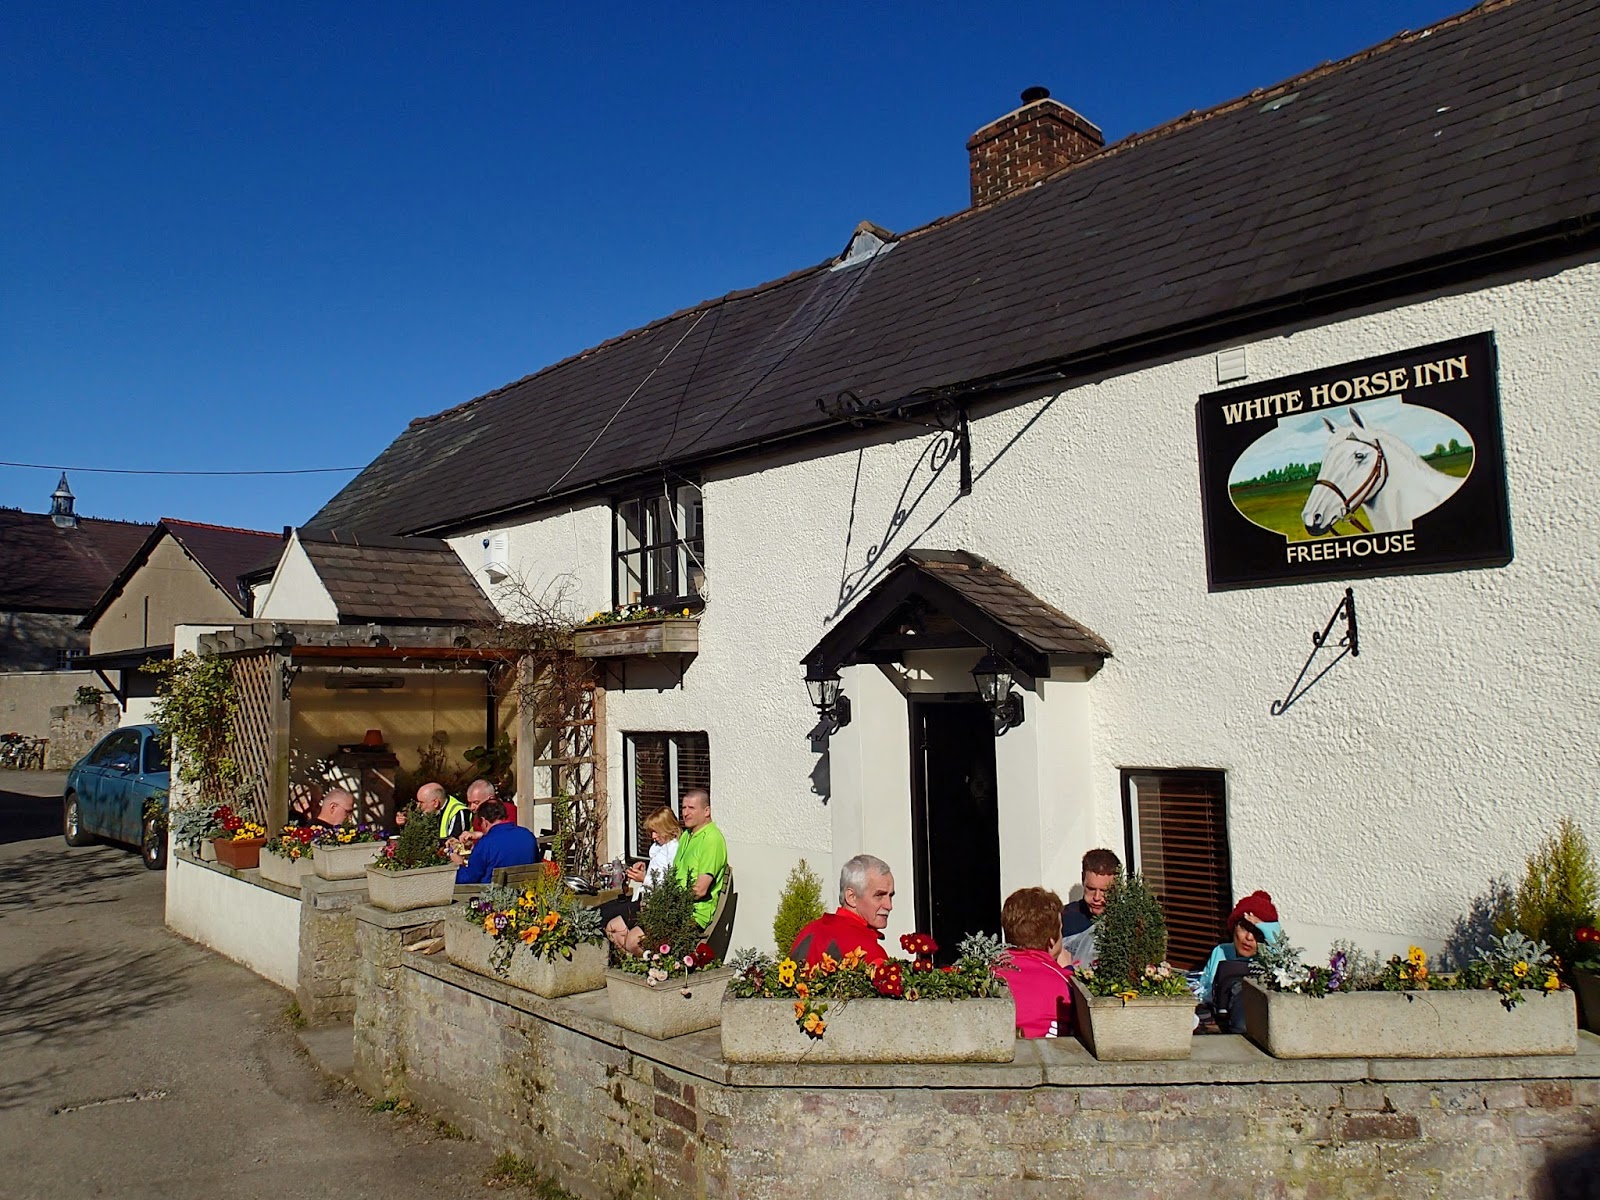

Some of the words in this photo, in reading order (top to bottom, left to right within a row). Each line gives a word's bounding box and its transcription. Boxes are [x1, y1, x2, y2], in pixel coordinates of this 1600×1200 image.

[1222, 391, 1302, 425] WHITE
[1310, 367, 1409, 407] HORSE
[1414, 356, 1469, 388] INN
[1287, 534, 1416, 563] FREEHOUSE
